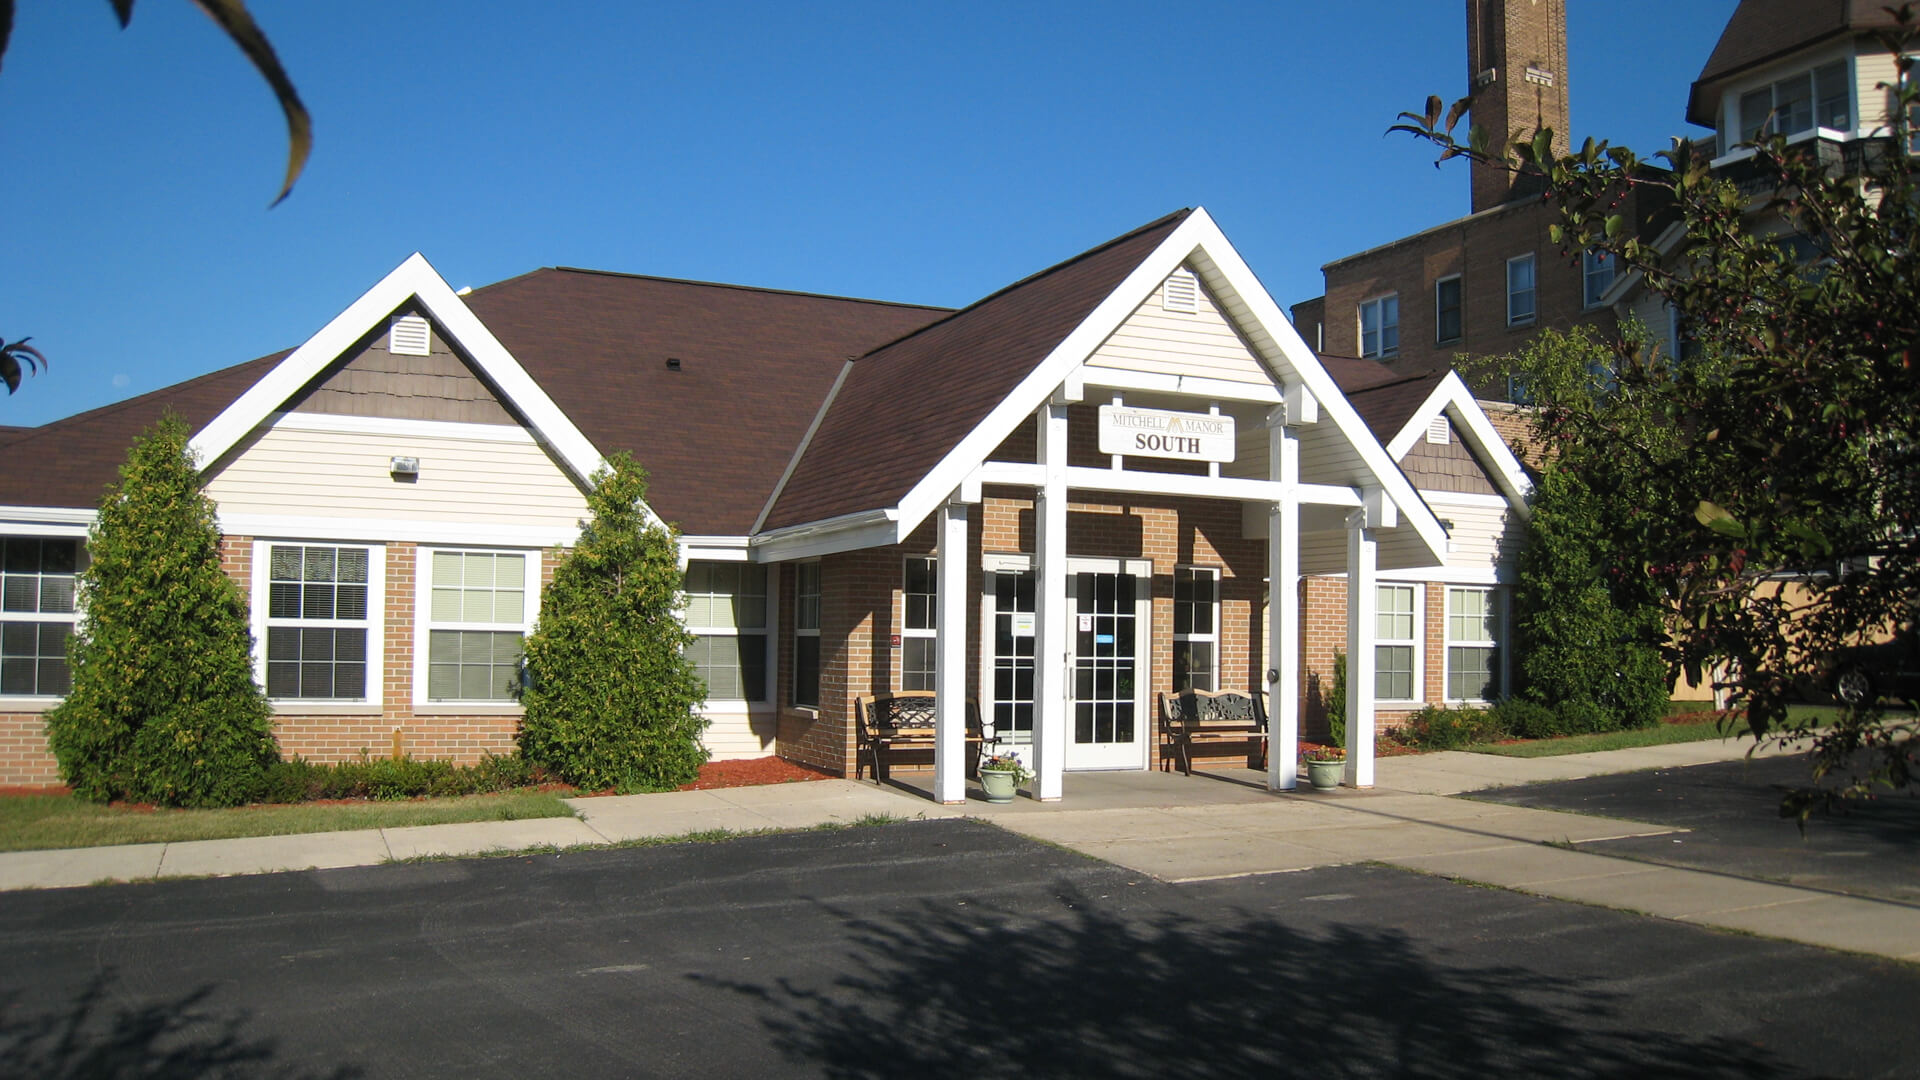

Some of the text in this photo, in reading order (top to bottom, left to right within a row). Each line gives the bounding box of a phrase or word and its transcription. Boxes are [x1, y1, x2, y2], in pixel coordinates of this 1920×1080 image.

[1113, 414, 1224, 433] MITCHELL MANOR
[1136, 433, 1200, 454] SOUTH
